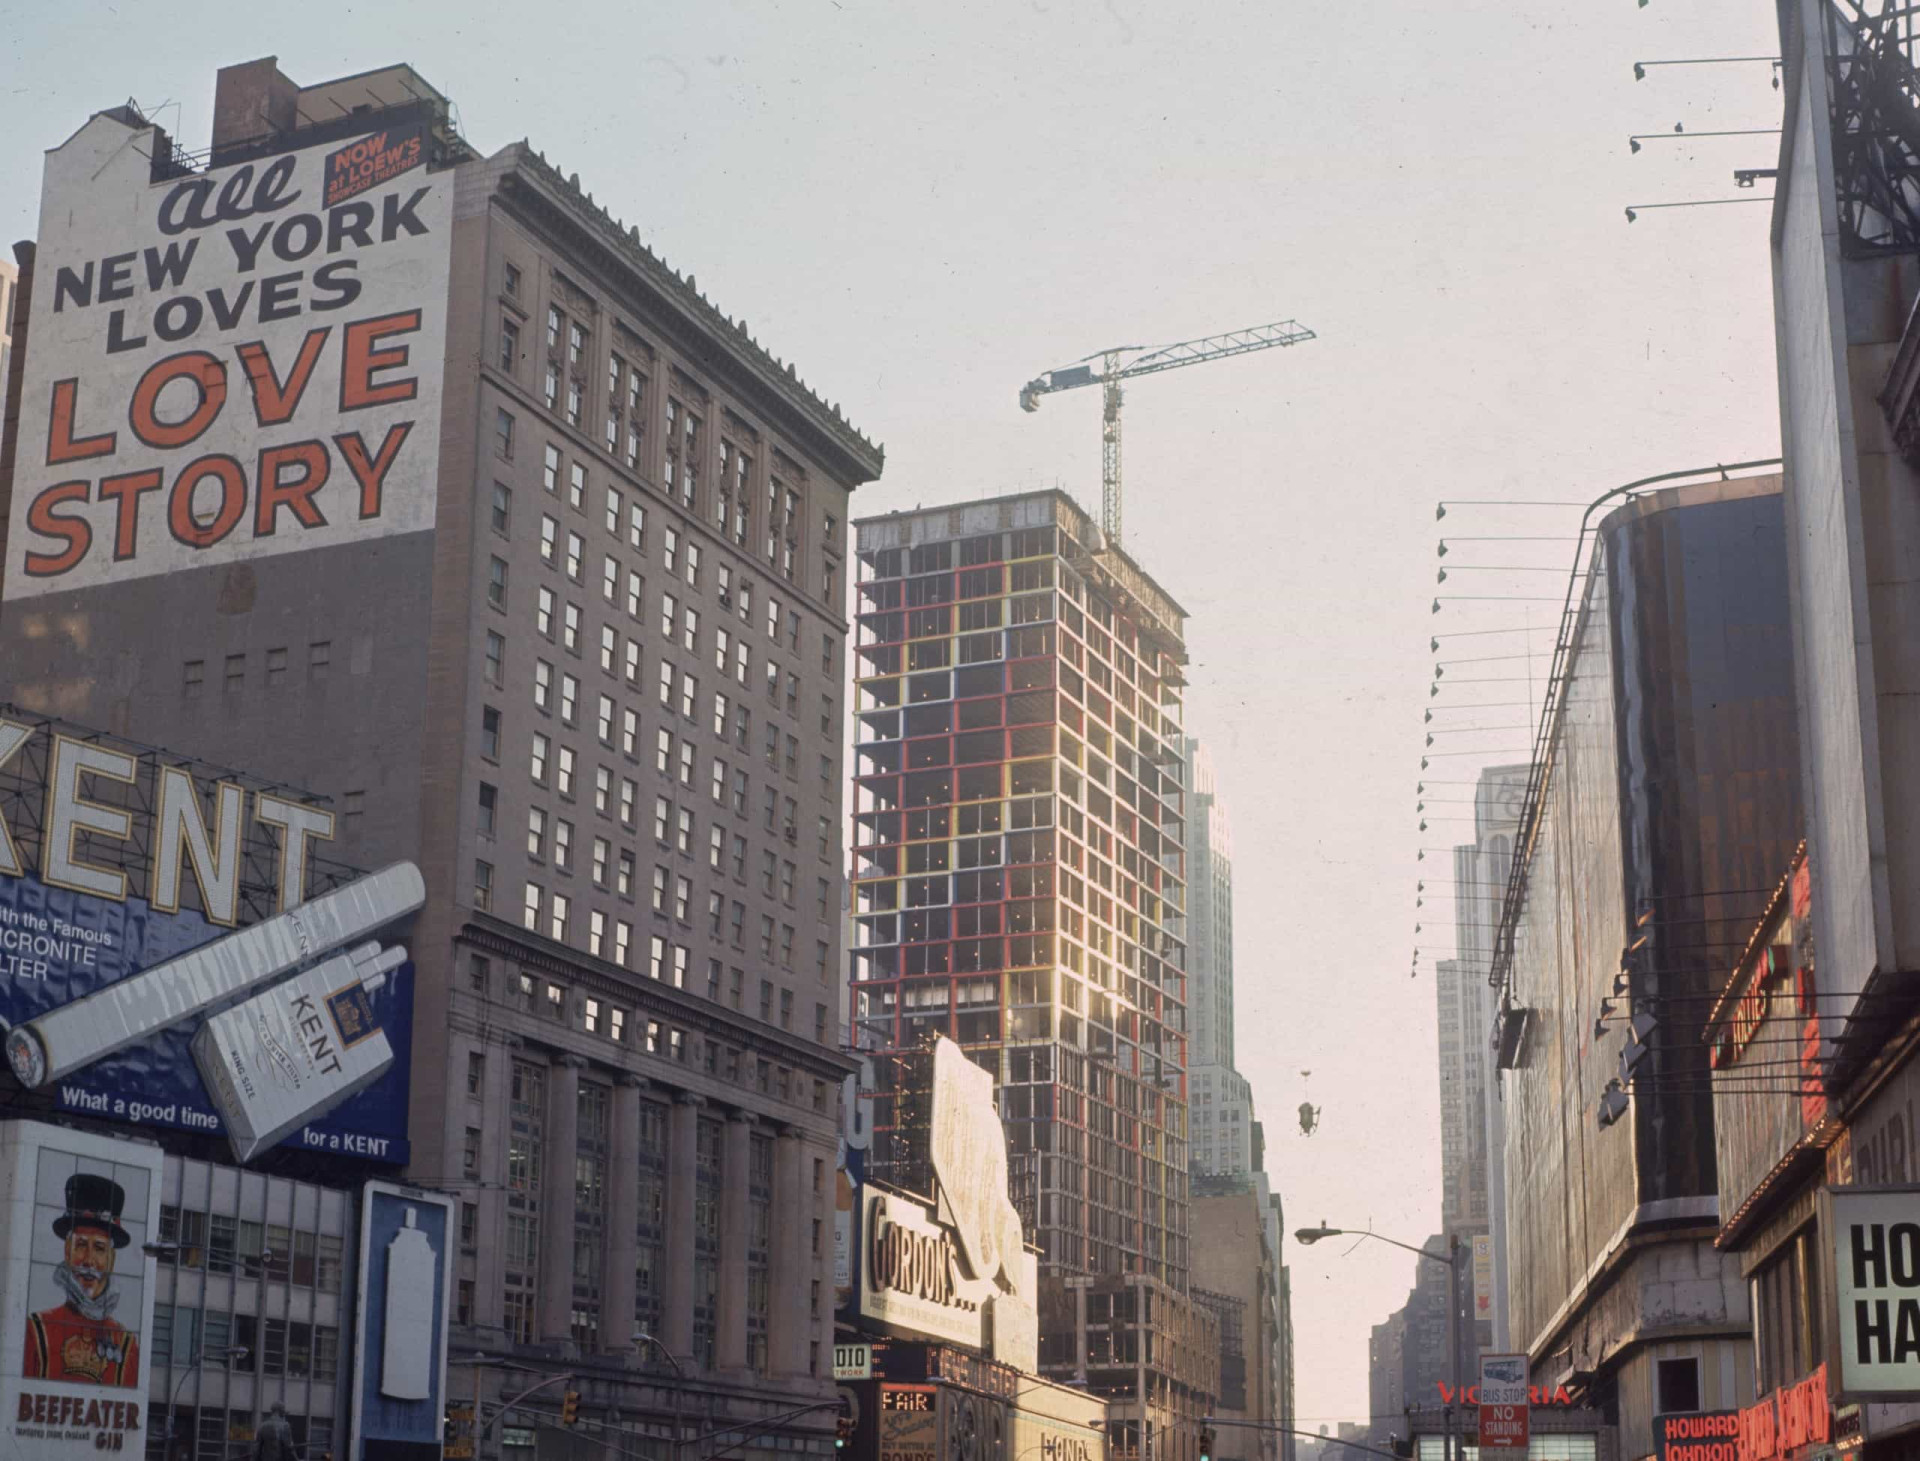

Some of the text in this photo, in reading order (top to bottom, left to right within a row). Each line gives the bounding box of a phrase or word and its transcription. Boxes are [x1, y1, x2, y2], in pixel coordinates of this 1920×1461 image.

[328, 138, 421, 193] at LOEW'S
[334, 132, 388, 173] NOW
[157, 155, 302, 235] all
[53, 186, 432, 313] NEW YORK
[106, 259, 363, 354] LOVES
[45, 308, 423, 467] LOVE
[23, 420, 416, 578] STORY
[24, 912, 48, 931] the
[53, 918, 112, 946] Famous
[290, 993, 342, 1076] KENT
[230, 1049, 256, 1099] KING SIZE
[62, 1086, 219, 1130] What a good time
[303, 1127, 390, 1157] for a KENT
[17, 1392, 140, 1430] BEEFEATER
[882, 1392, 928, 1411] FAIR
[1483, 1387, 1527, 1403] BUS STOP
[1493, 1406, 1514, 1421] NO
[95, 1431, 124, 1452] GIN
[1485, 1420, 1524, 1436] STANDING
[1665, 1415, 1739, 1440] HOWARD
